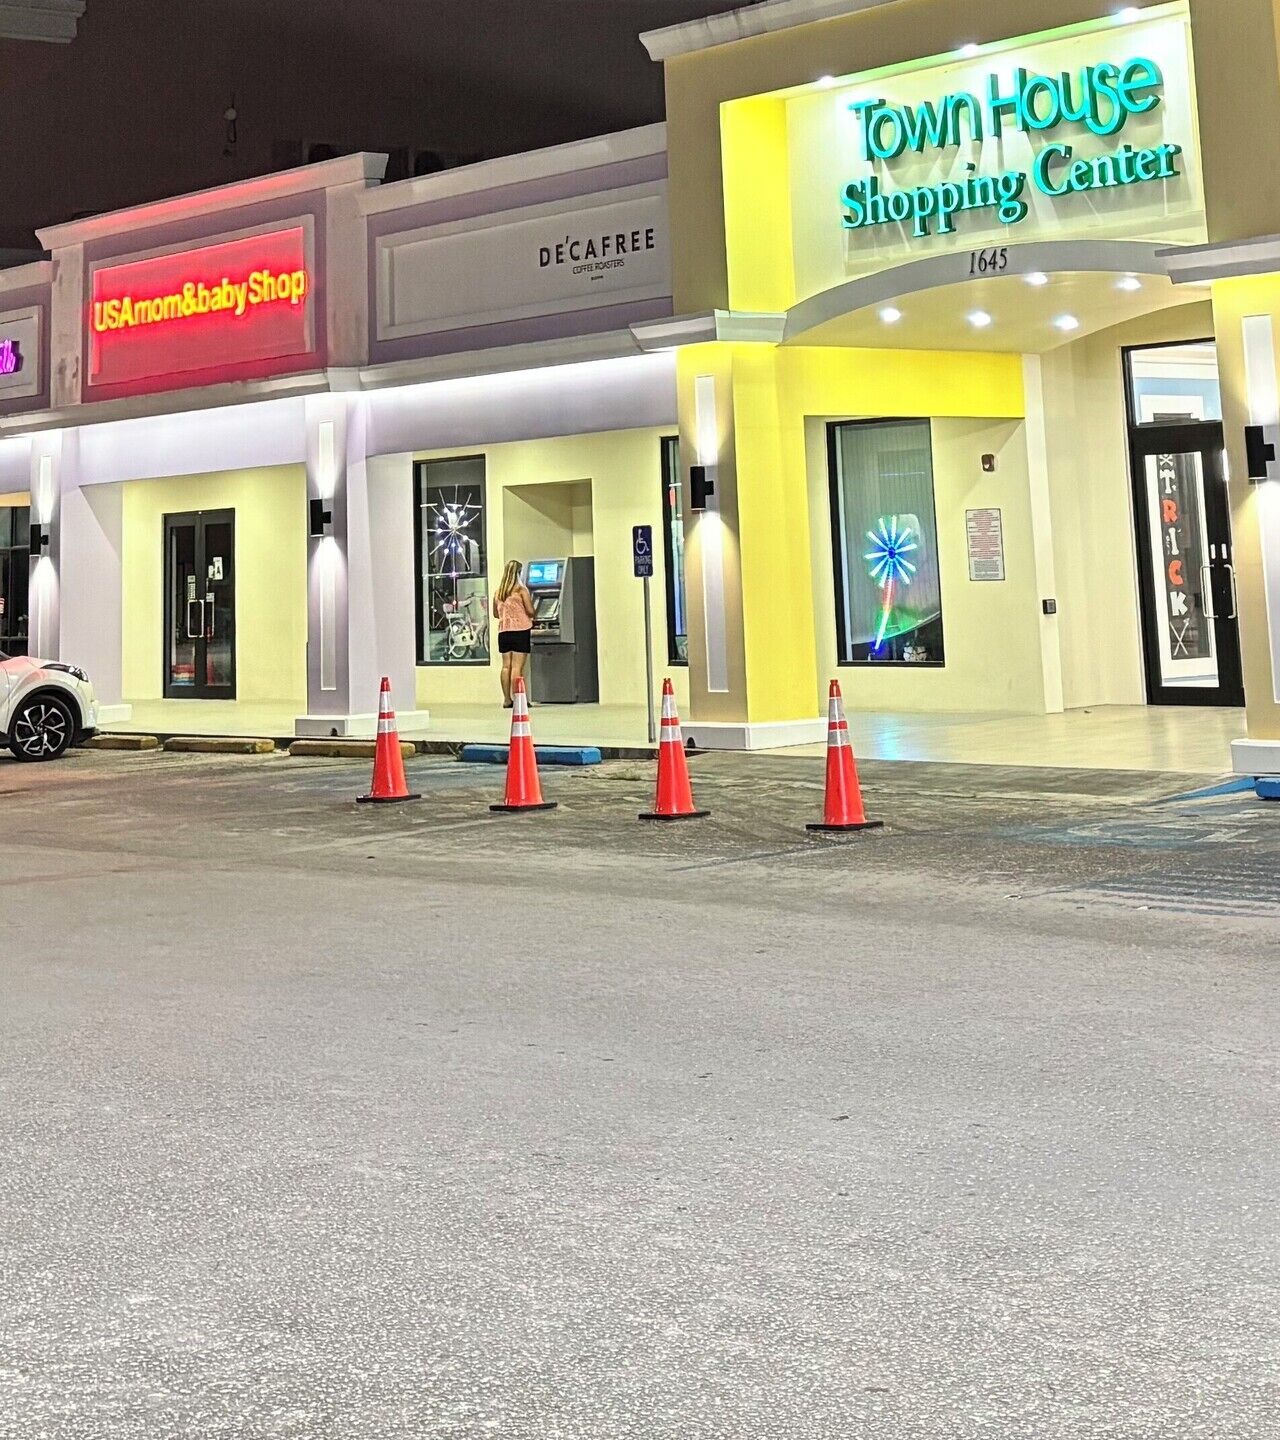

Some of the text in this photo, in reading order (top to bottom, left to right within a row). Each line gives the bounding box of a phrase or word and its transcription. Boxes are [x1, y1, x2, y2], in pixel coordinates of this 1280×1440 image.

[840, 142, 1182, 237] Shopping Center
[572, 258, 625, 275] COFFEE ROASTERS
[969, 248, 1008, 274] 1645
